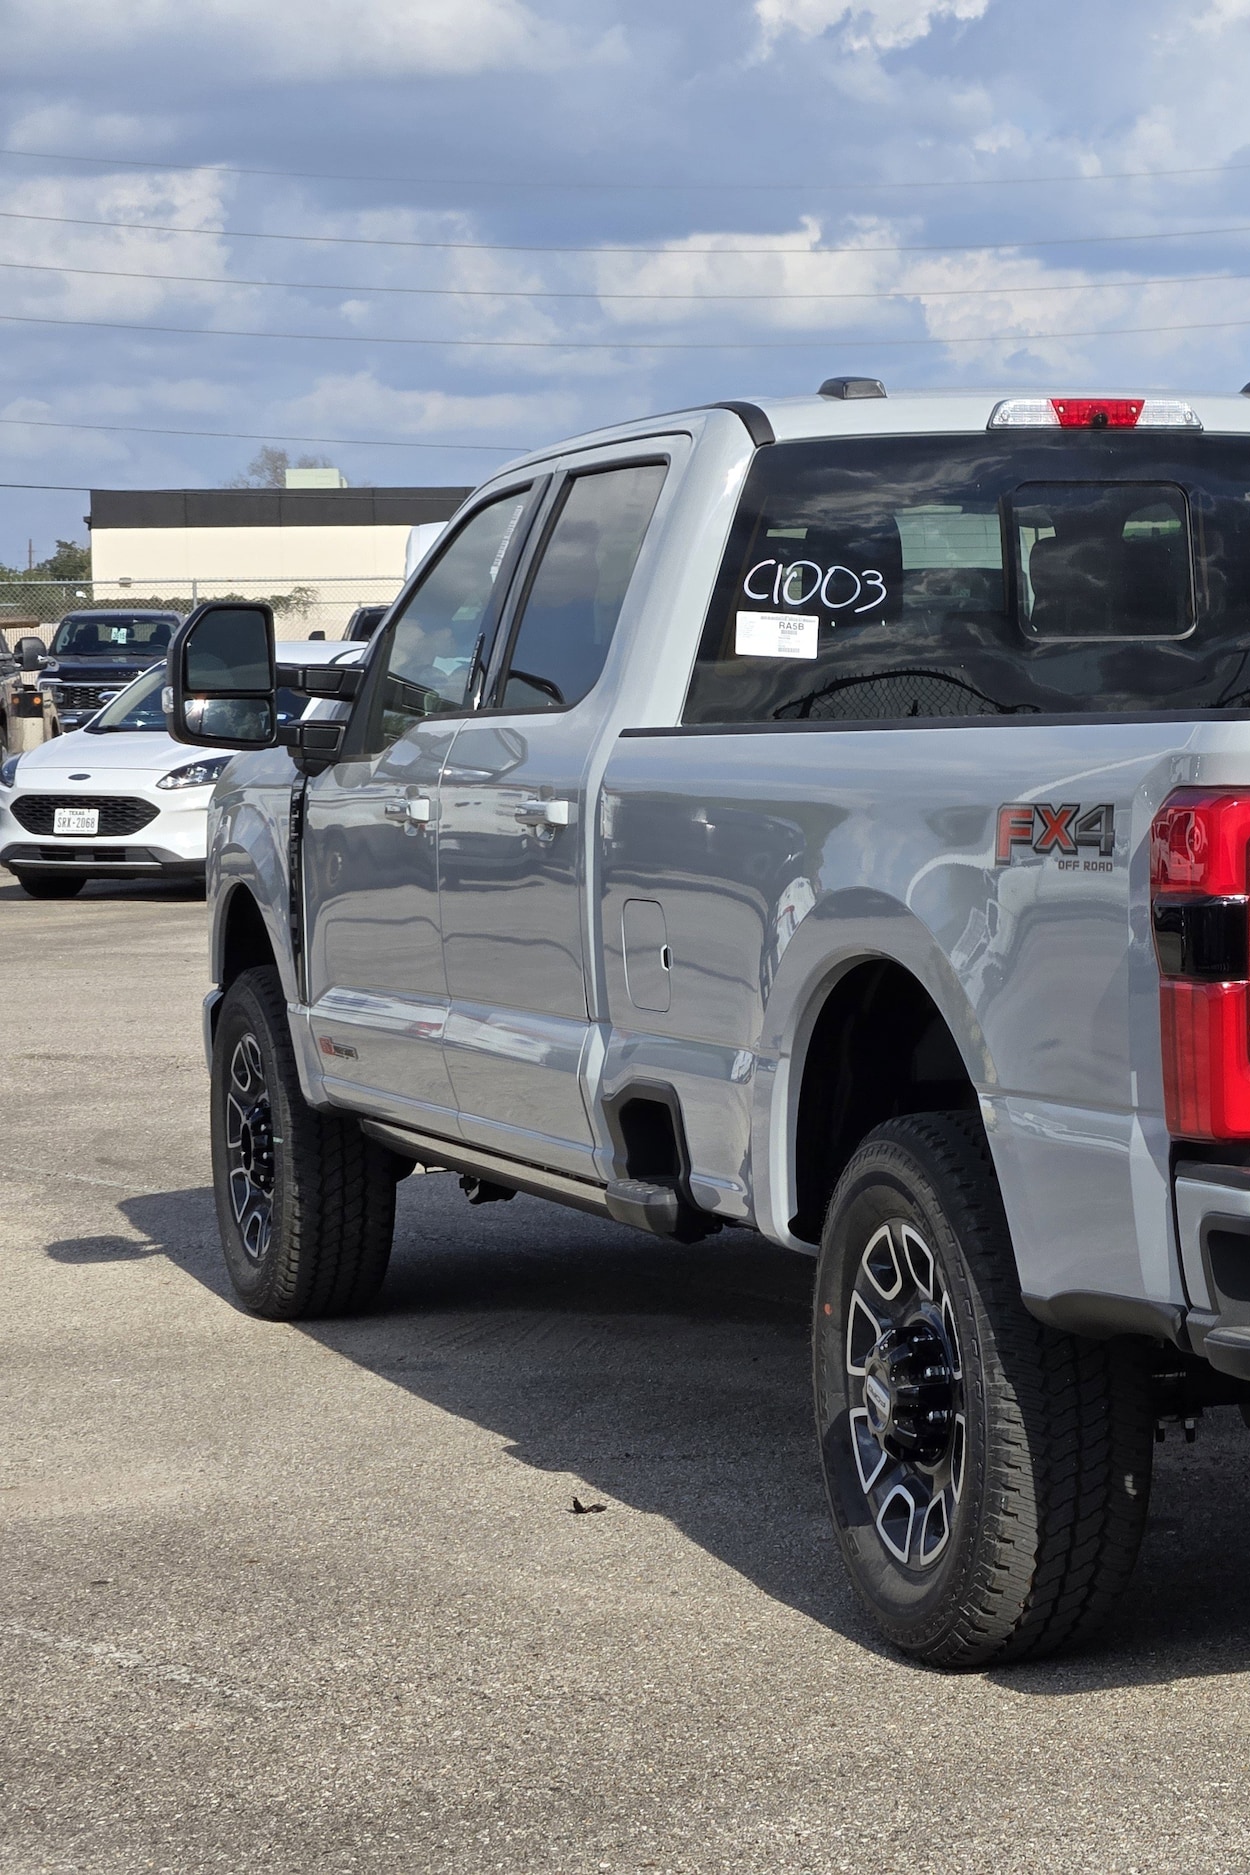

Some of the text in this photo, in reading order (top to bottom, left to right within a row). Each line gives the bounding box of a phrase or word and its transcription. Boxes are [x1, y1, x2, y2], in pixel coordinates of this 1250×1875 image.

[743, 558, 887, 614] C1003
[778, 621, 805, 631] RA5B
[995, 802, 1115, 866] FX4
[1058, 860, 1113, 872] OFF ROAD
